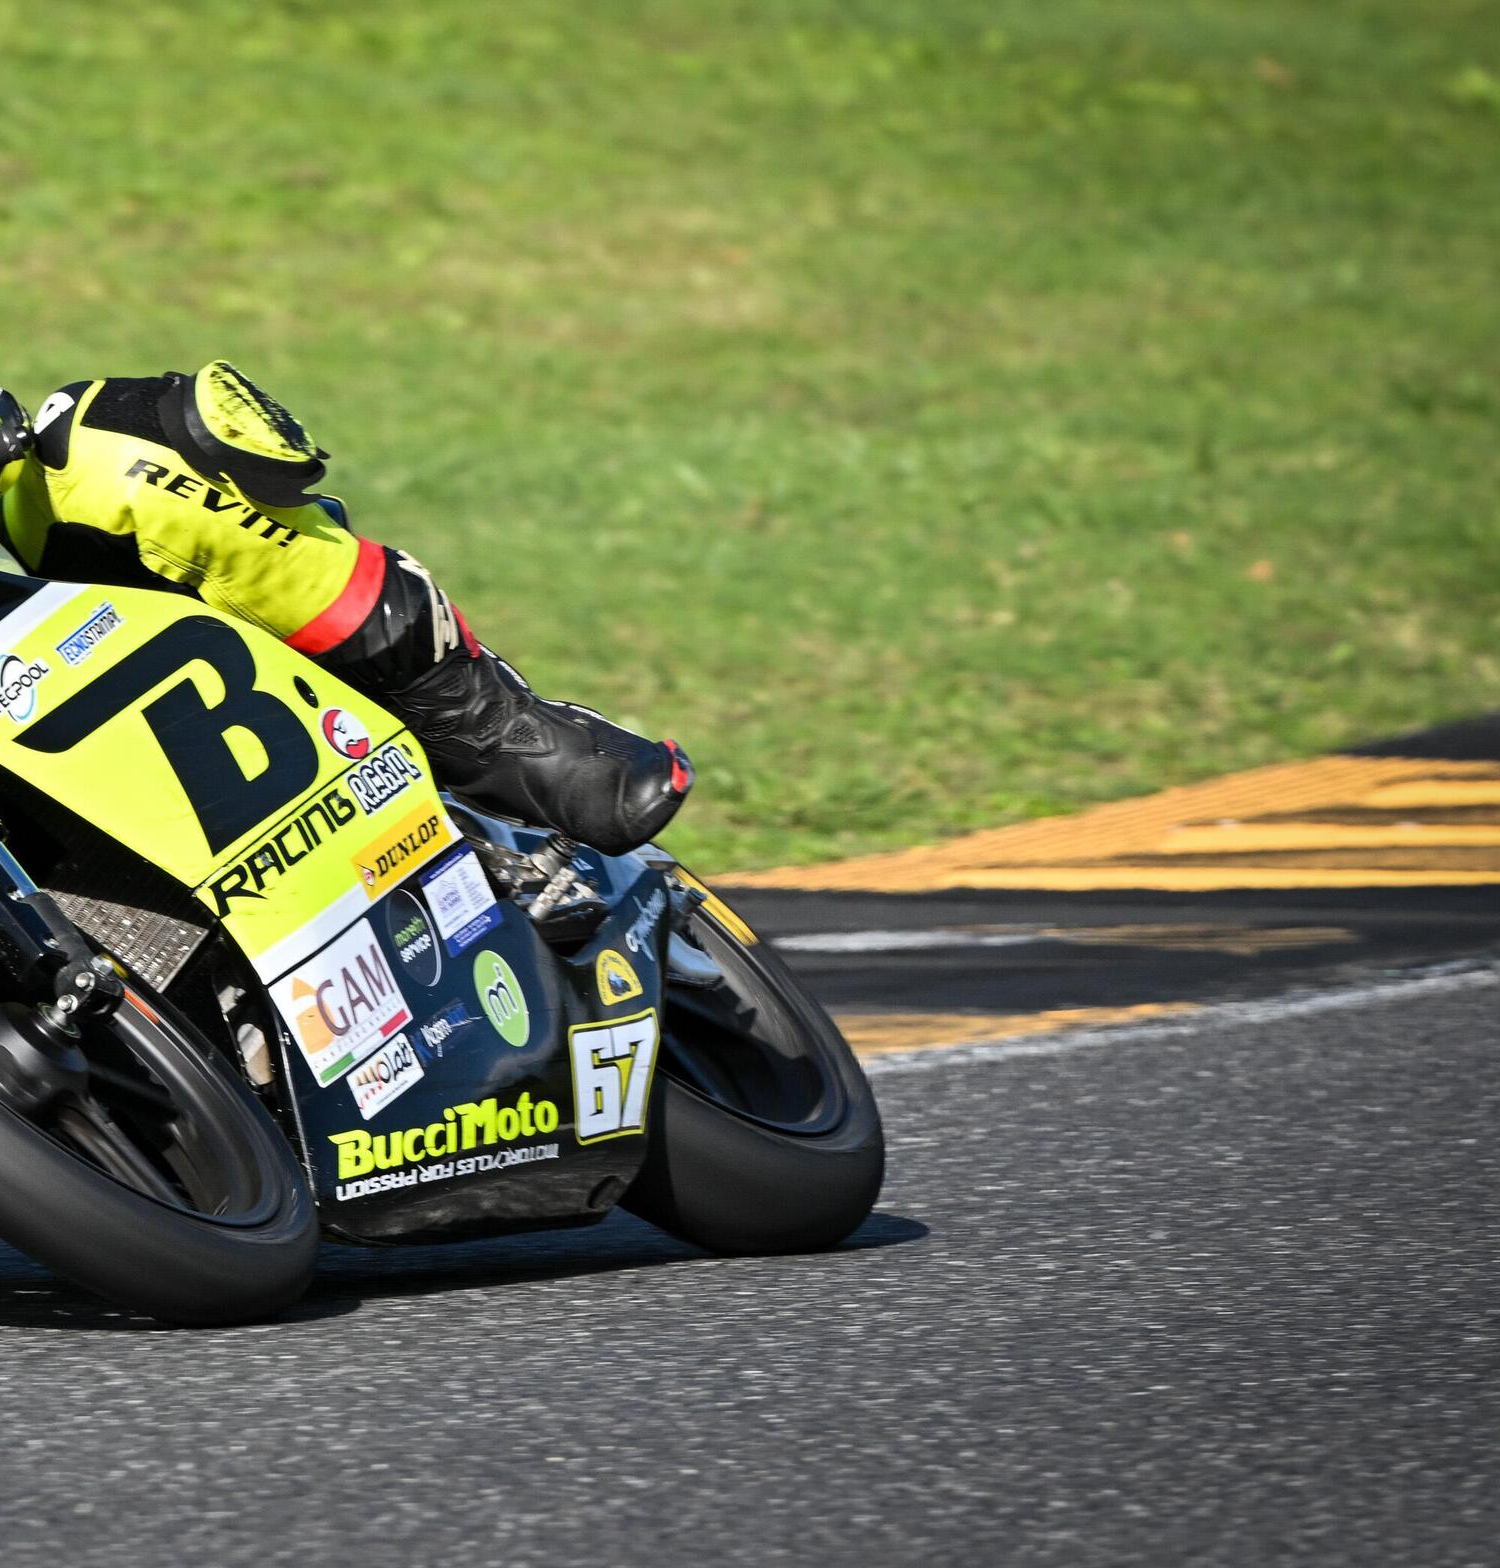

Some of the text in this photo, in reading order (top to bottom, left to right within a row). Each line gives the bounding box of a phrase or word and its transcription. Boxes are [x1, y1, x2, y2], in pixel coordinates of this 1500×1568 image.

[125, 459, 300, 548] REV'IT!
[208, 789, 357, 920] RACING
[375, 815, 439, 877] DUNLOP
[316, 943, 396, 1037] GAM
[573, 1016, 654, 1141] 67
[335, 1168, 419, 1202] PASSION
[416, 1160, 455, 1185] FOR
